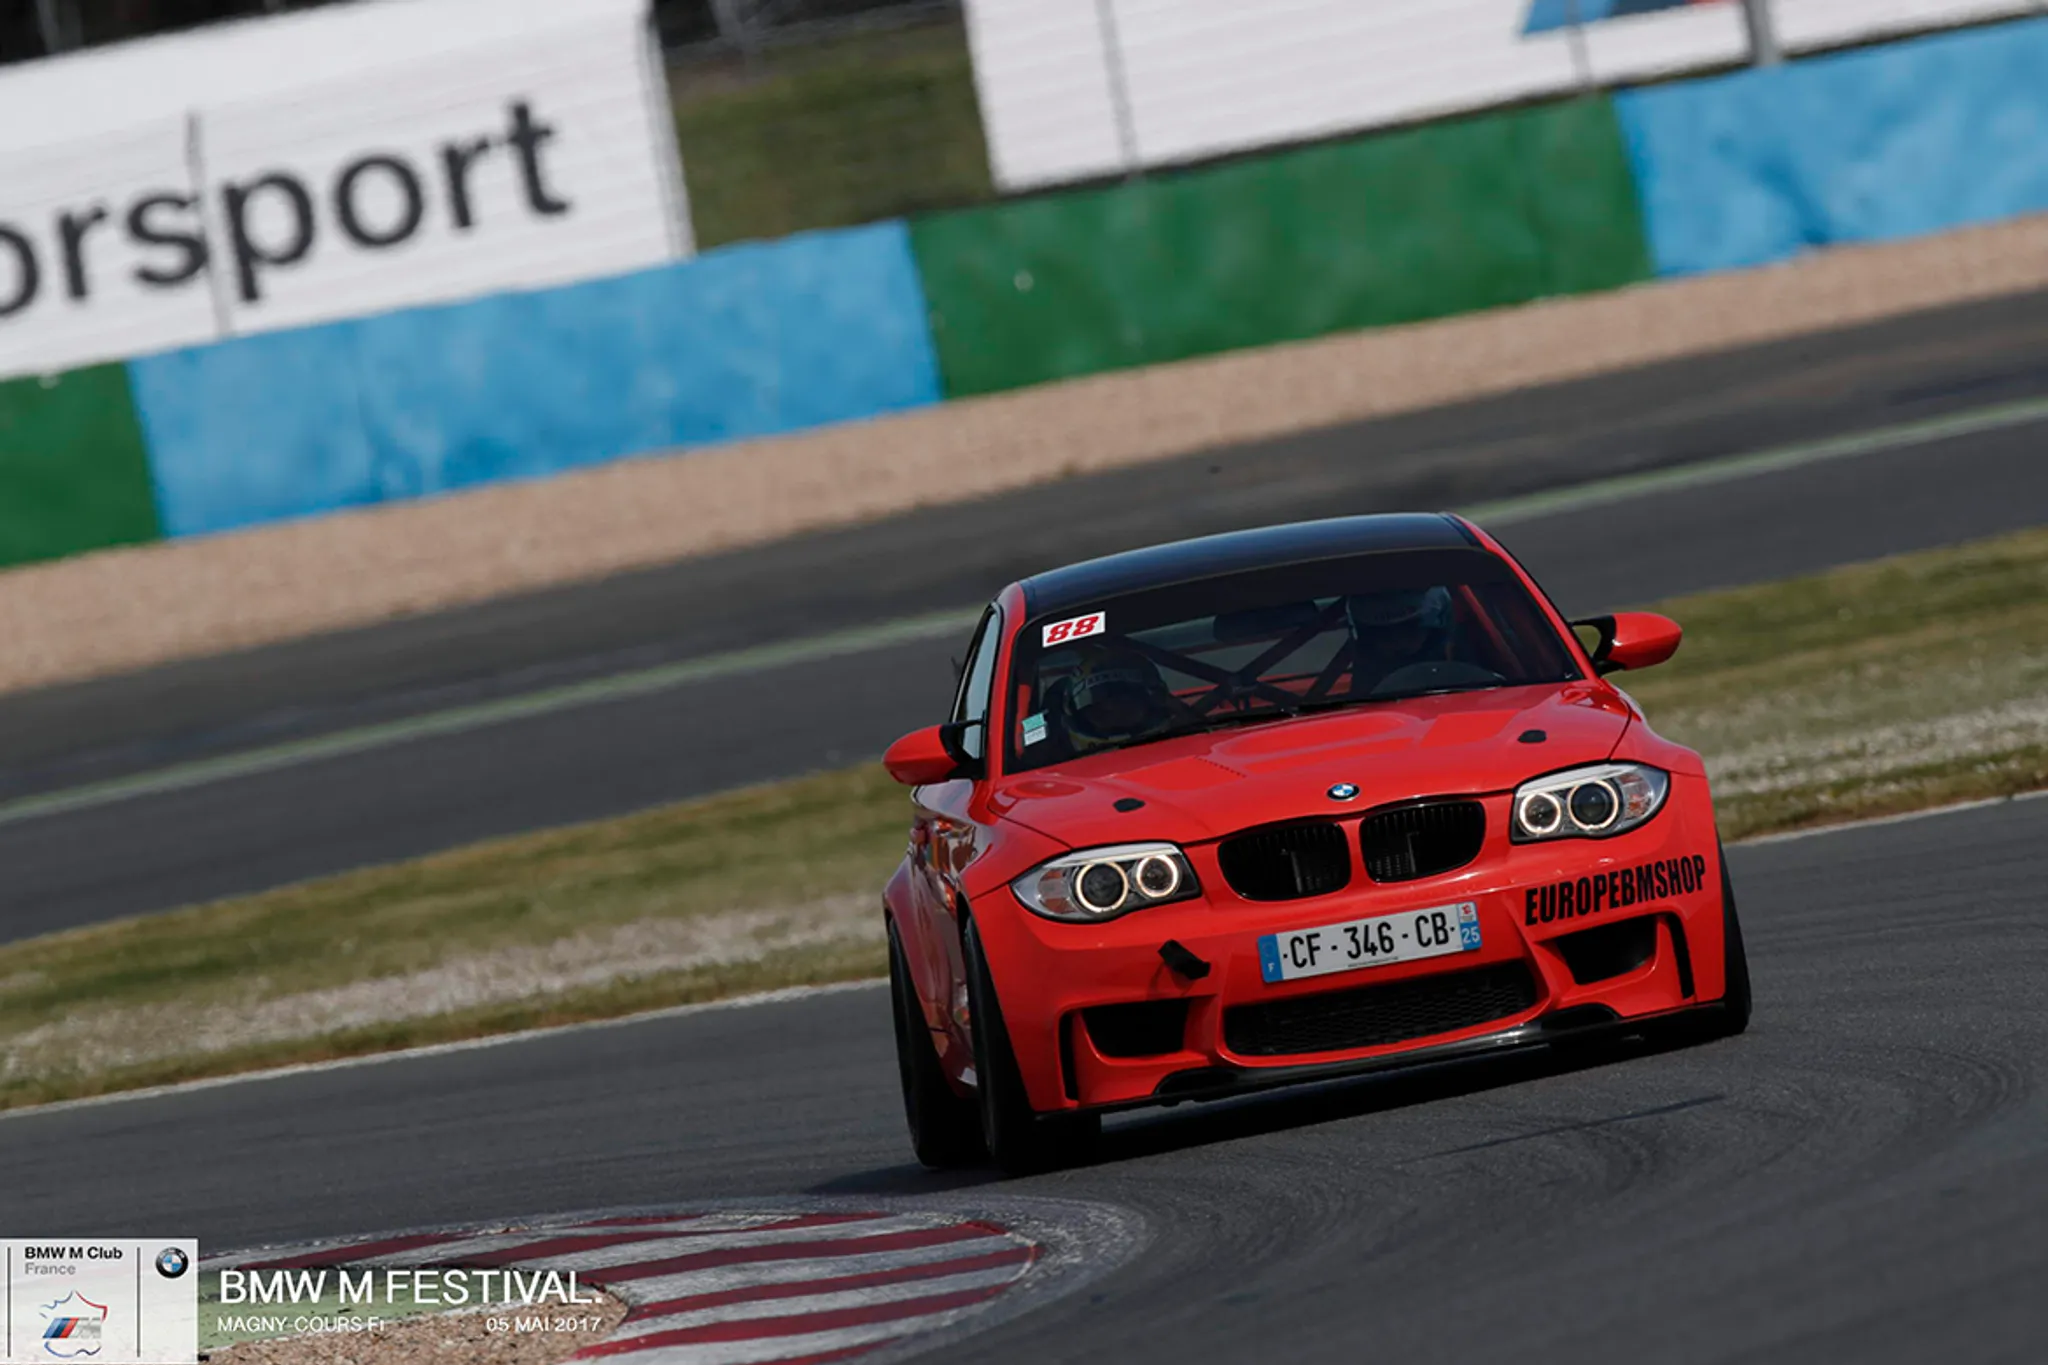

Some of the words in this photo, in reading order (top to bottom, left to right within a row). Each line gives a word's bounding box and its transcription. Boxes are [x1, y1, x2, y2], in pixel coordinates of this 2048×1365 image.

[1046, 615, 1100, 644] 88
[1525, 854, 1706, 926] EUROPEBMSHOP
[1461, 926, 1481, 944] 25
